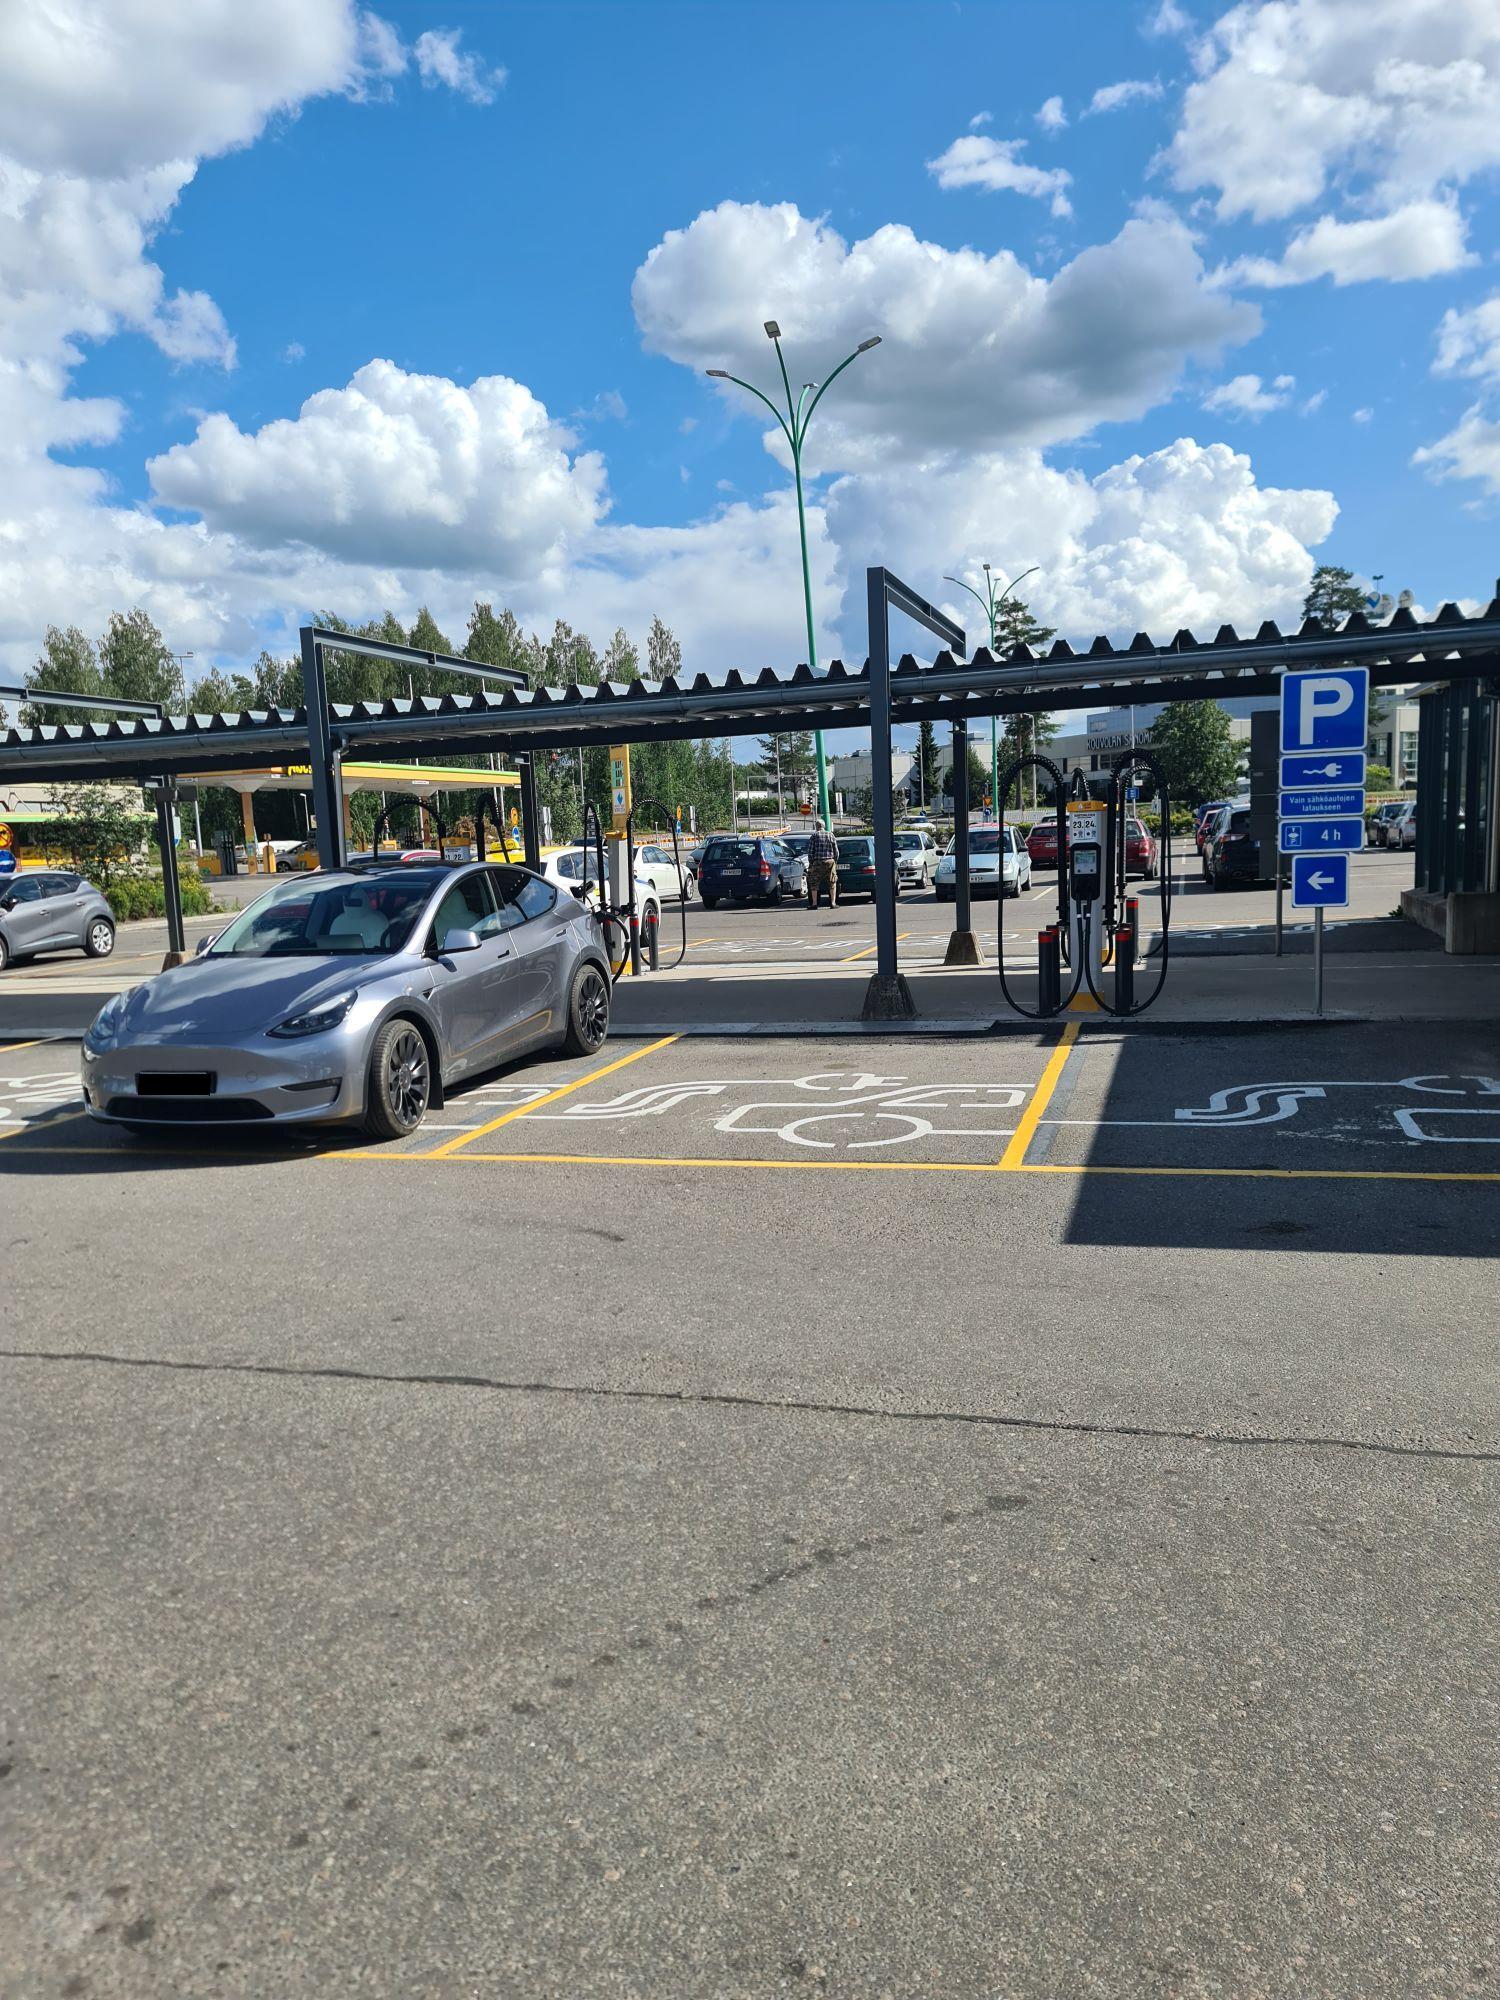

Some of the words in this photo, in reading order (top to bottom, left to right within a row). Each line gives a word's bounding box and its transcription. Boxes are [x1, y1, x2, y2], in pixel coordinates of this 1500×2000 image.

[1300, 678, 1354, 745] P
[1088, 736, 1121, 750] KOUVOLAN
[1289, 796, 1305, 804] Vain
[1302, 804, 1341, 812] lataukseen
[1321, 829, 1329, 841] 4
[1333, 829, 1341, 841] h
